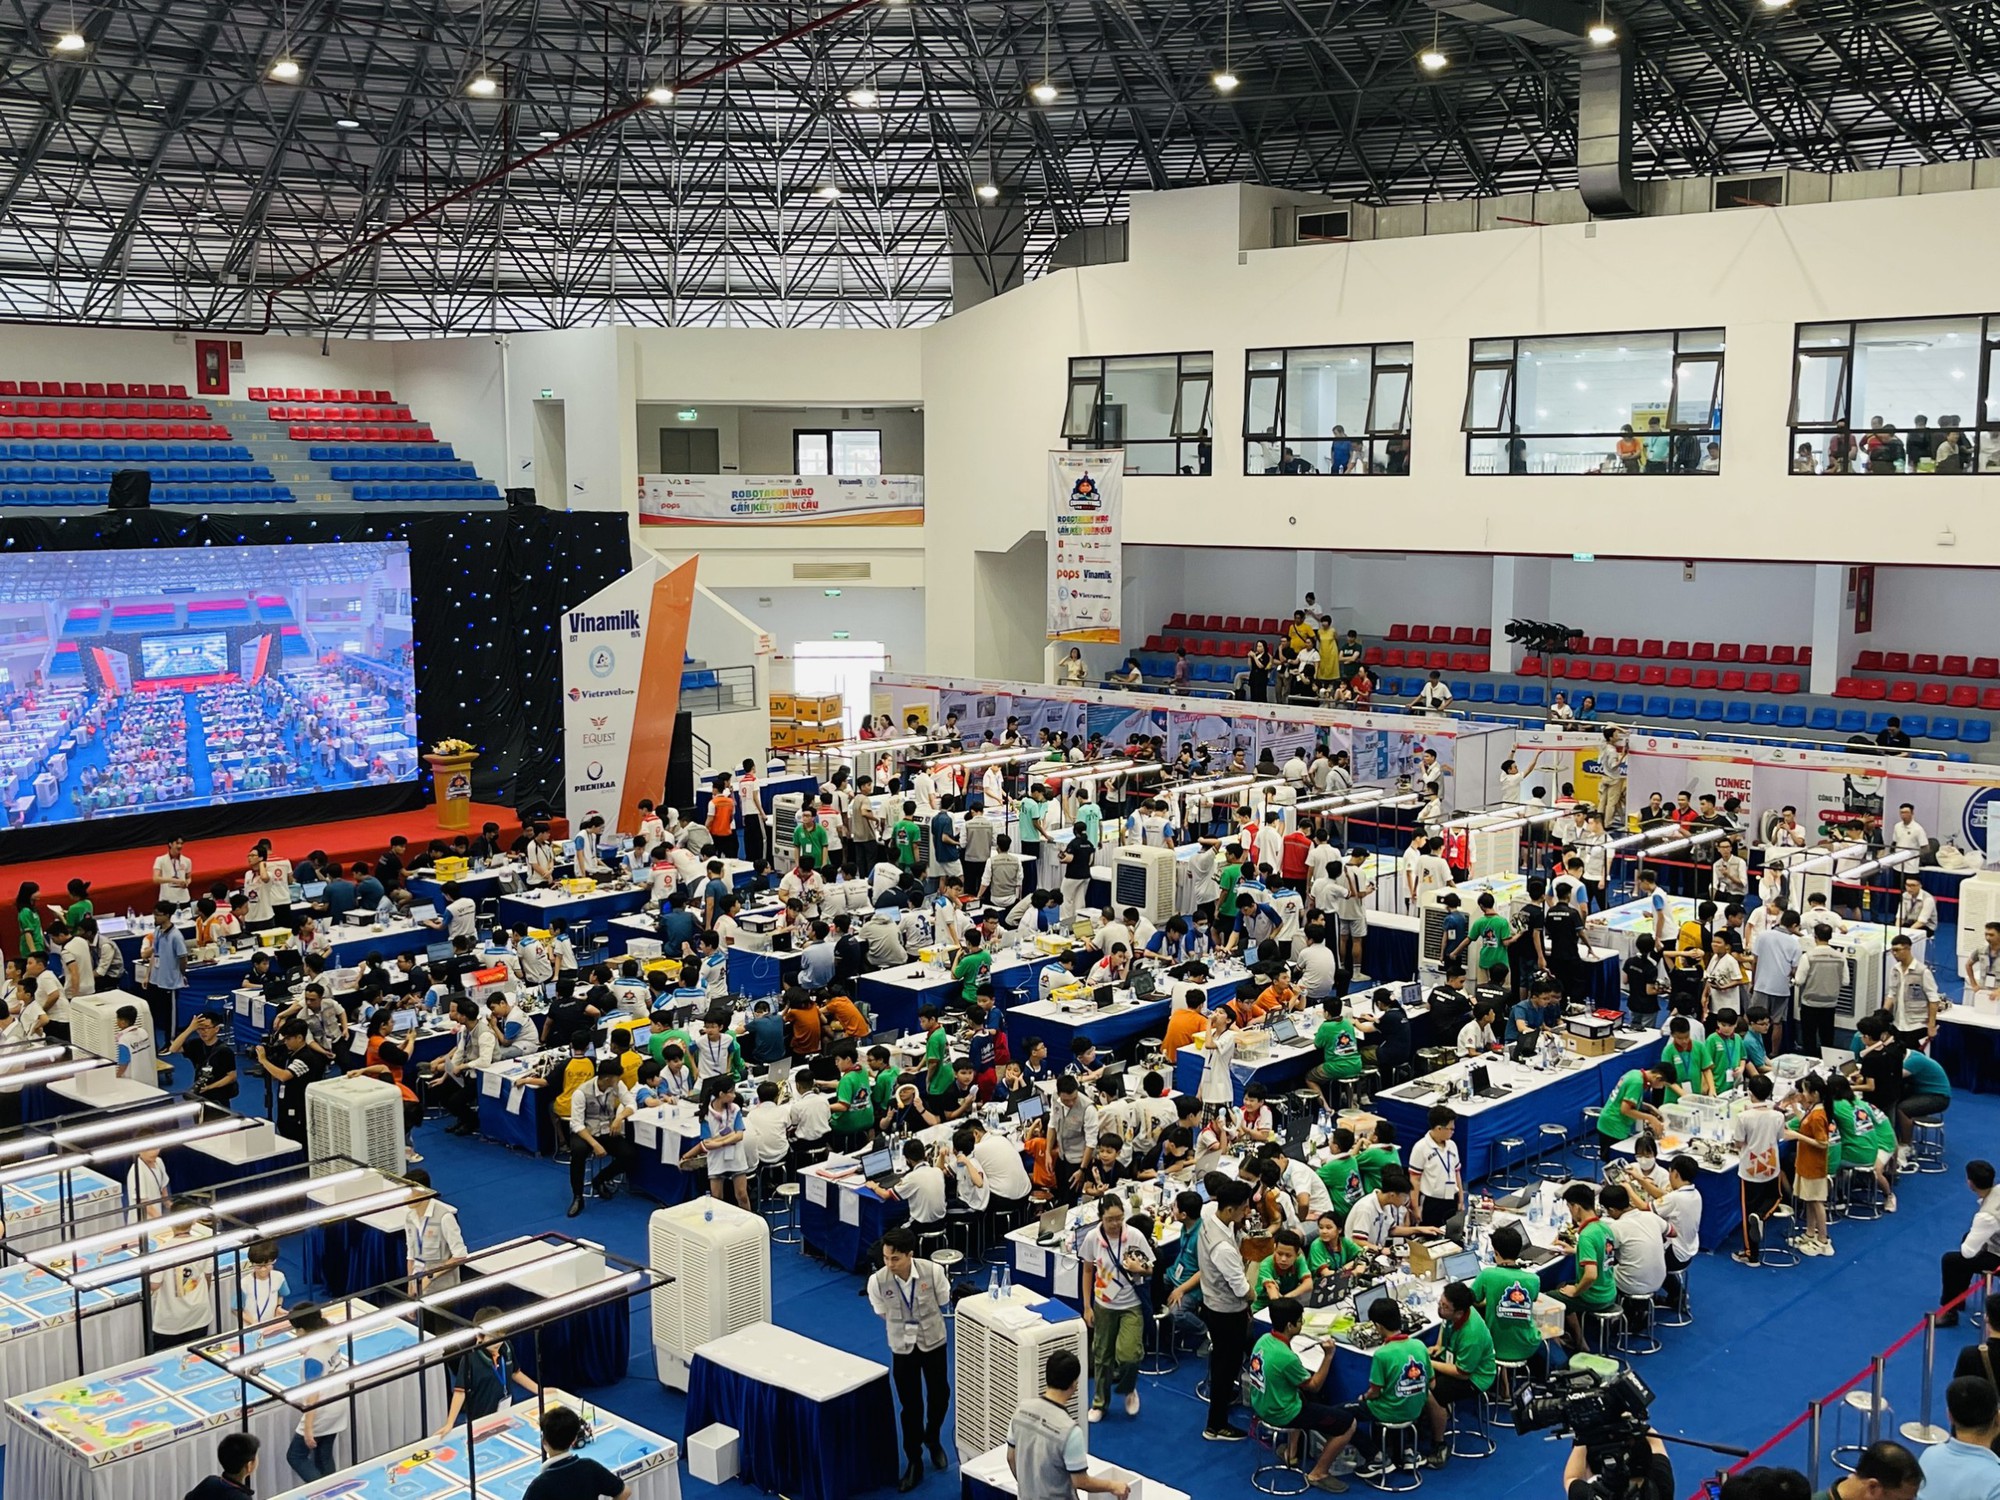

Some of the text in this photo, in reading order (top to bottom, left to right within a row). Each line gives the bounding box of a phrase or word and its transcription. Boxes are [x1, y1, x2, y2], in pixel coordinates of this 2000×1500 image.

[791, 487, 814, 496] WRO
[660, 502, 680, 510] pops
[1056, 569, 1080, 580] pops
[1083, 569, 1112, 579] Vinamilk
[569, 610, 640, 633] Vinamilk
[581, 688, 621, 699] Vietravel
[582, 732, 616, 744] EQUEST
[574, 781, 616, 792] PHENIKAA
[173, 1421, 204, 1436] Vinamilk
